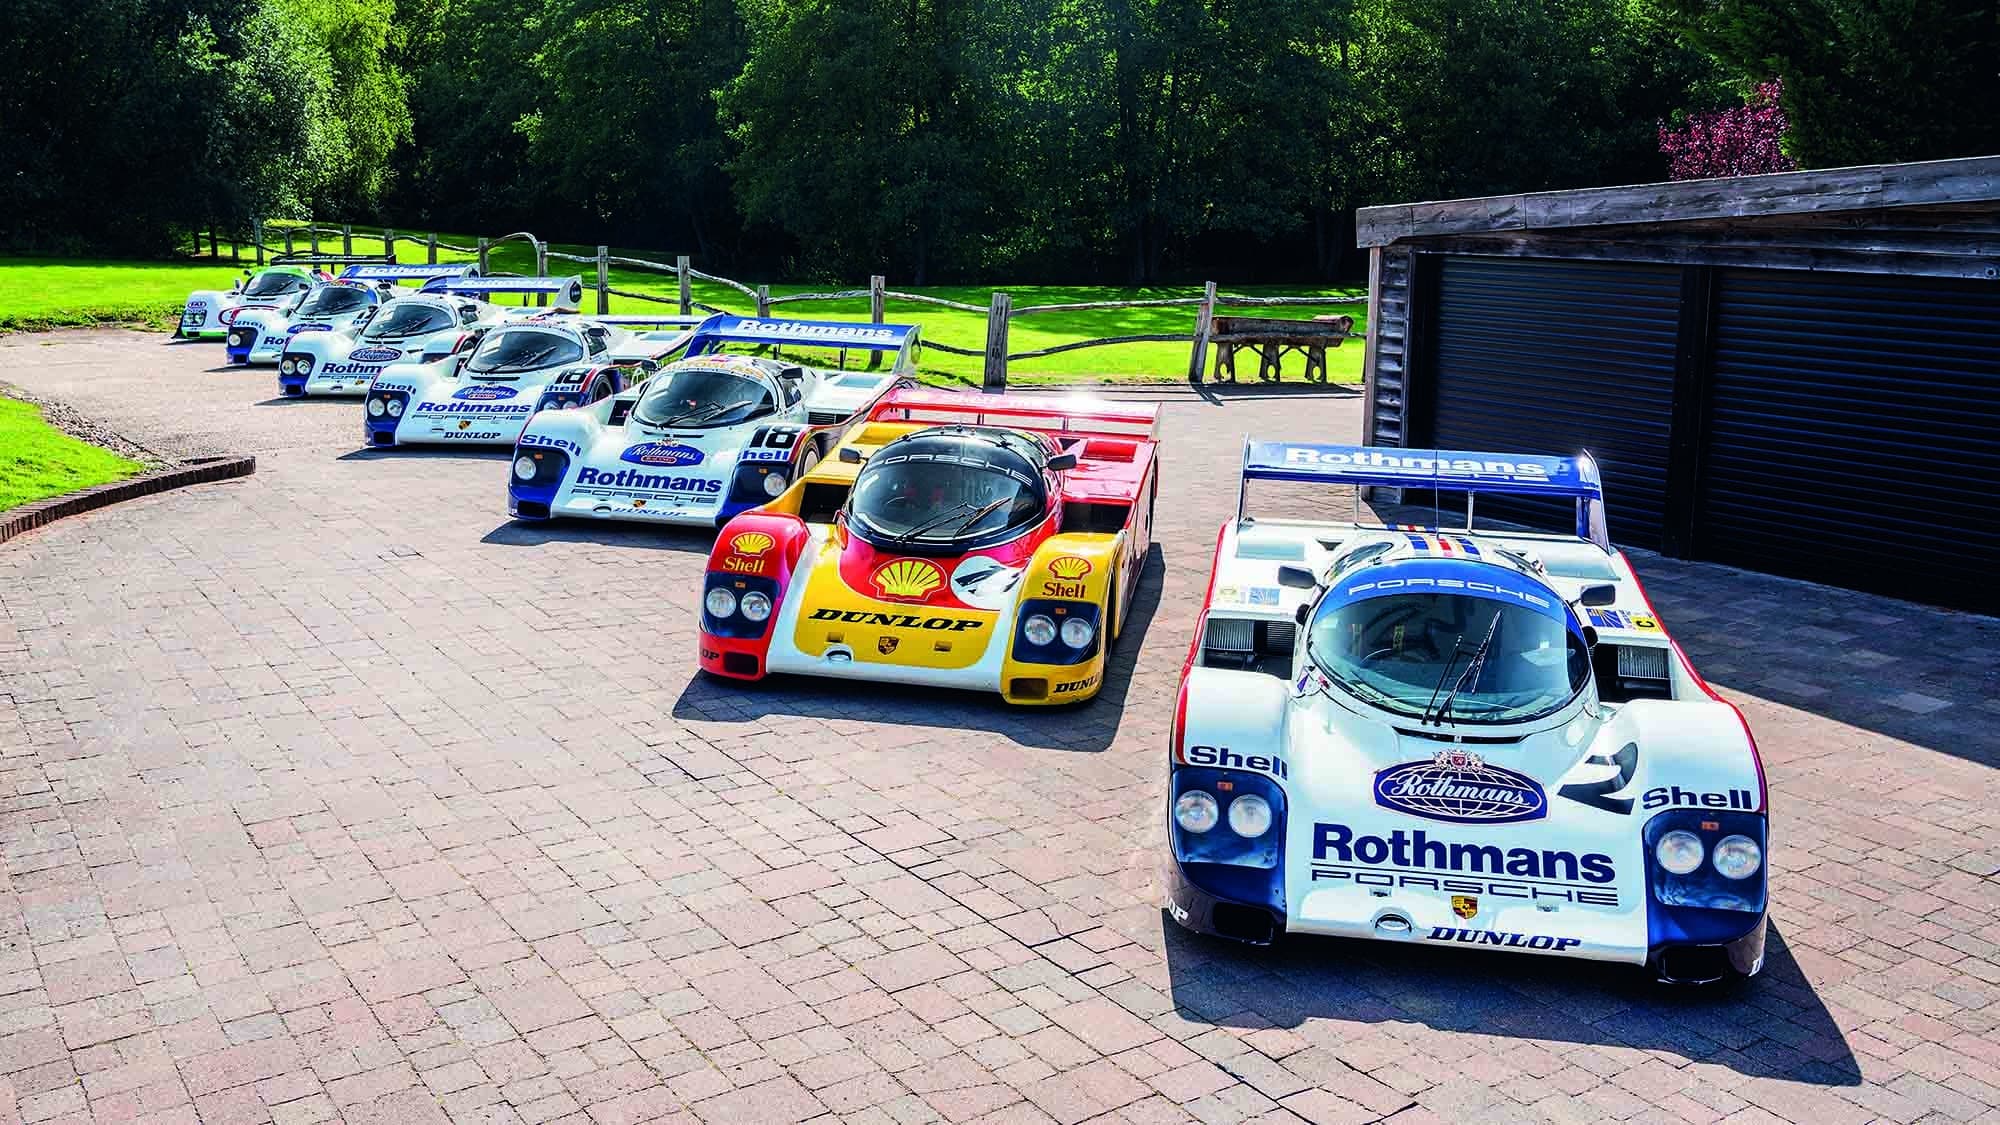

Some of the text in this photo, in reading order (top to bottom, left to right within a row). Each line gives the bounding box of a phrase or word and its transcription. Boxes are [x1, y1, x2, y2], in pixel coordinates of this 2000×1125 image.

[736, 320, 894, 339] Rothmans
[321, 362, 382, 373] Rothm
[374, 382, 416, 394] Shell
[417, 401, 531, 413] Rothmans
[521, 434, 582, 456] Shell
[630, 445, 697, 460] Rothmans
[1286, 447, 1548, 475] Rothmans
[576, 466, 723, 493] Rothmans
[571, 488, 719, 504] PORSCHE
[722, 556, 765, 575] Shell
[1042, 581, 1086, 598] Shell
[1349, 578, 1550, 609] PORSCHE
[808, 608, 984, 632] DUNLOP
[1053, 672, 1100, 693] DUNL
[1189, 745, 1288, 781] Shell
[1391, 774, 1531, 806] Rothmans
[1557, 742, 1638, 815] 2
[1642, 786, 1752, 810] Shell
[1311, 822, 1616, 883] Rothmans
[1311, 869, 1619, 906] PORSCHE
[1427, 926, 1581, 951] DUNLOP
